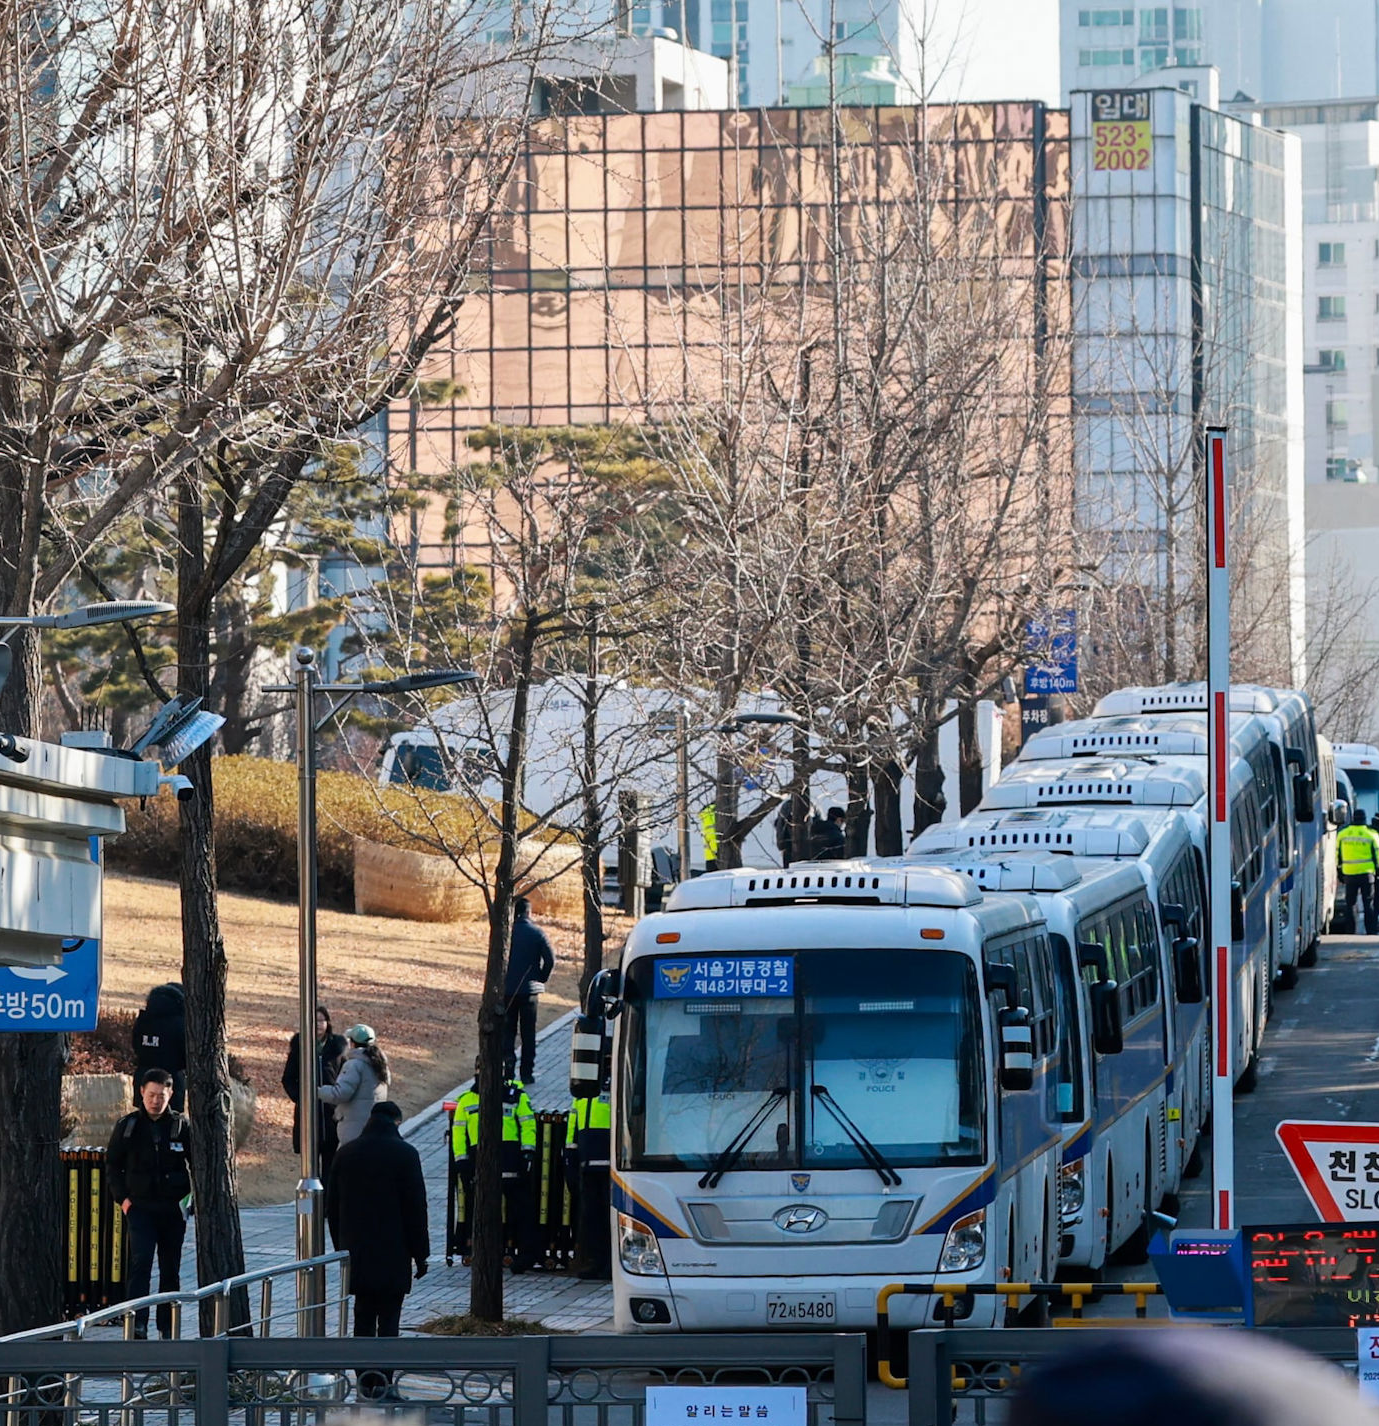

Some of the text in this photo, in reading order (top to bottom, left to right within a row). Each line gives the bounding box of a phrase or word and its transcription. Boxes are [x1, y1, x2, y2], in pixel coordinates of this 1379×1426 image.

[1095, 93, 1148, 119] 임대
[1094, 149, 1150, 171] 2002
[1022, 710, 1049, 723] 주차장
[694, 979, 788, 994] 제48기동대-2
[866, 1085, 896, 1093] POLICE
[768, 1302, 834, 1318] 72서5480
